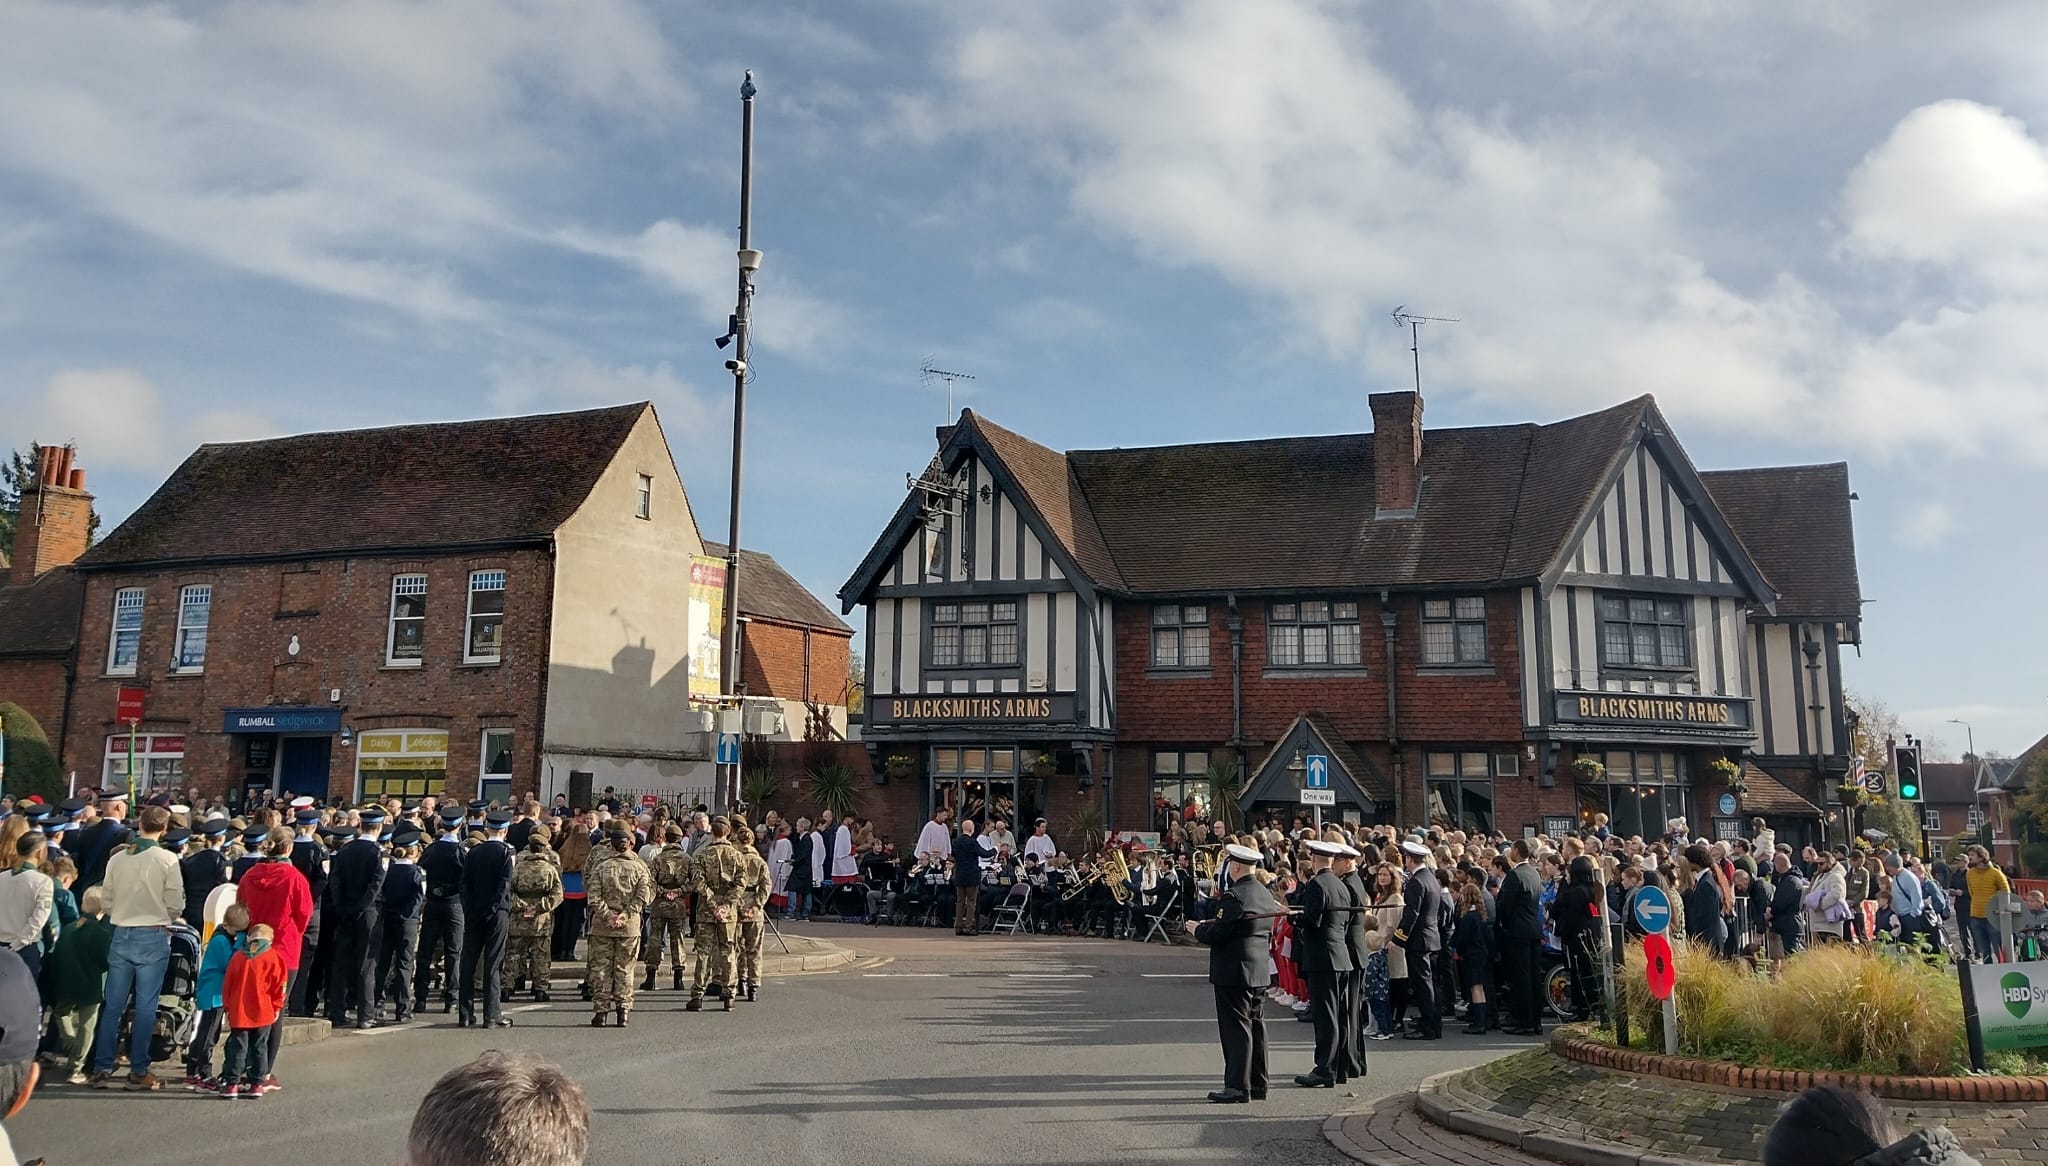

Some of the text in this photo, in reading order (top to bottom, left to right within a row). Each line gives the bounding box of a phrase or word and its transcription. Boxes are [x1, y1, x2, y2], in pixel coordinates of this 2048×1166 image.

[893, 699, 1050, 718] BLACKSMITHS ARMS
[1579, 697, 1729, 723] BLACKSMITHS ARMS
[239, 712, 325, 729] RUMBALL sedgwick
[371, 739, 392, 748] Daisy
[1549, 820, 1570, 830] CRAFT
[1720, 821, 1739, 831] CRAFT
[2003, 986, 2048, 1003] HBD Sy
